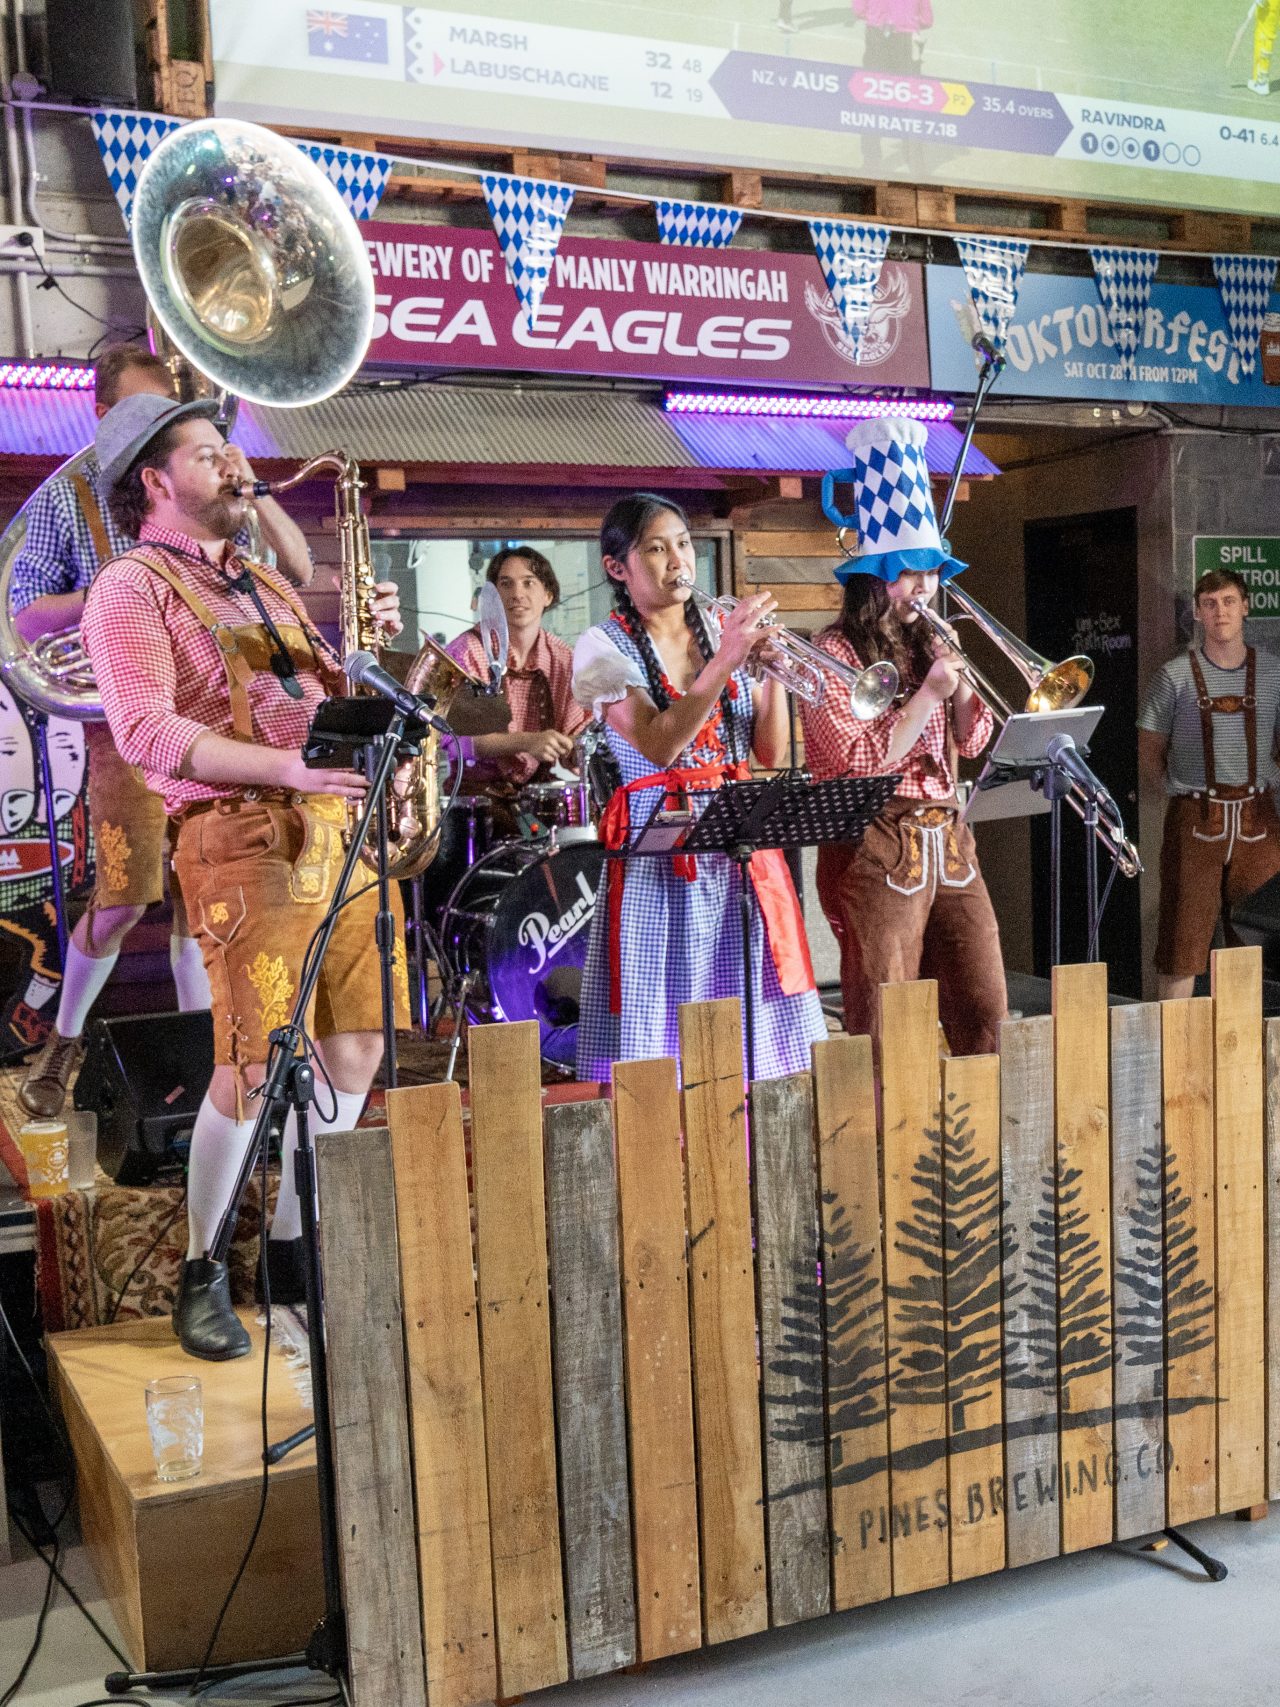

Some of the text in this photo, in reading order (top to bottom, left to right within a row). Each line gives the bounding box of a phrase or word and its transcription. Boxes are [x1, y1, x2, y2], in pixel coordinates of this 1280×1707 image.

[449, 26, 702, 73] MARSH 32 48
[450, 57, 703, 103] LABUSCHAGNE 12 19
[752, 69, 775, 86] NZ
[778, 76, 788, 87] v
[792, 70, 840, 93] AUS
[863, 77, 934, 106] 256-3
[982, 96, 1016, 115] 35.4
[1018, 104, 1054, 119] OVERS
[840, 110, 958, 138] RUN RATE 7.18
[1081, 109, 1280, 147] RAVINDRA 0-41 6.4
[461, 247, 494, 283] OF
[555, 254, 637, 293] MANLY
[642, 261, 789, 303] WARRINGAH
[512, 304, 793, 361] EAGLES
[1064, 361, 1198, 385] SAT OCT 28 FROM 12PM
[1220, 546, 1267, 564] SPILL
[518, 870, 598, 975] Pearl
[858, 1487, 949, 1549] PINES
[967, 1451, 1121, 1525] BREWING
